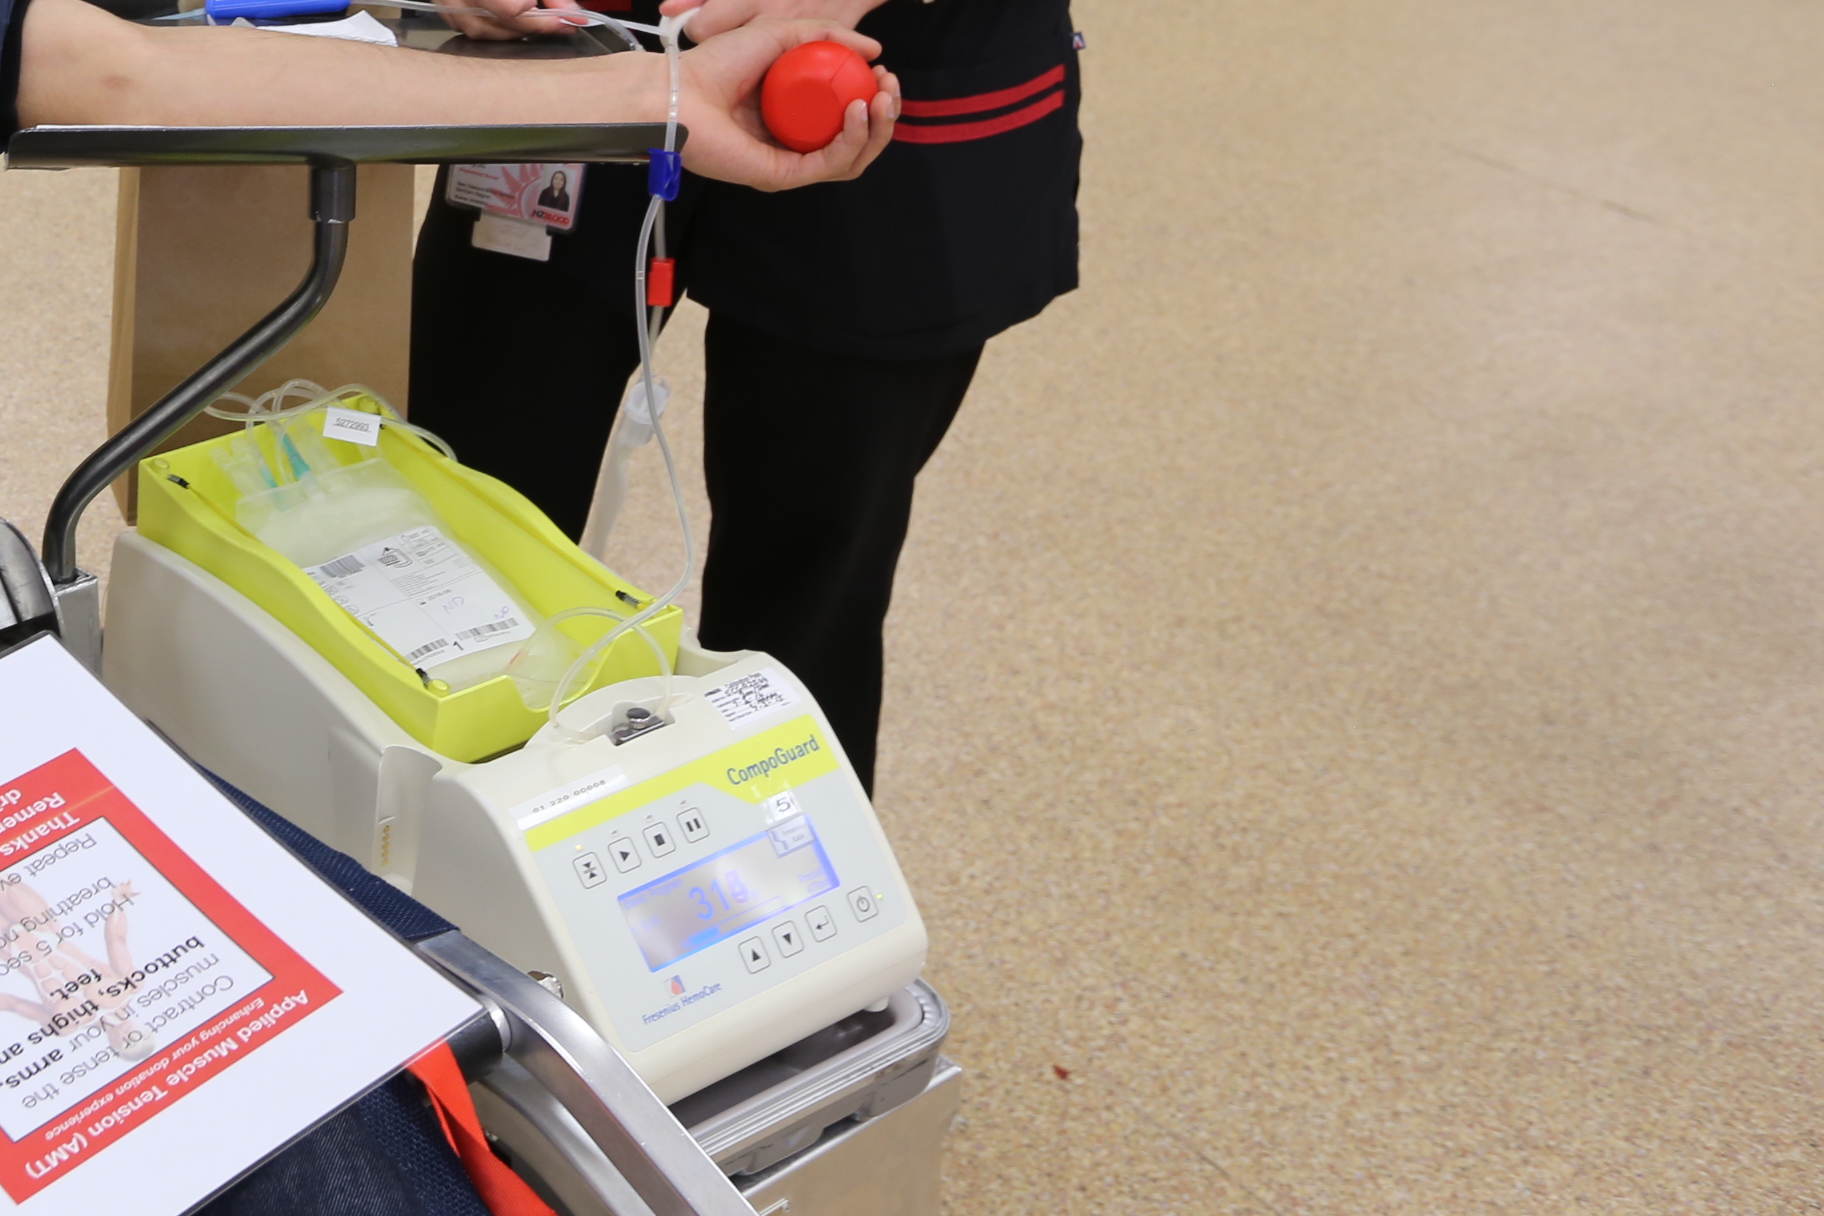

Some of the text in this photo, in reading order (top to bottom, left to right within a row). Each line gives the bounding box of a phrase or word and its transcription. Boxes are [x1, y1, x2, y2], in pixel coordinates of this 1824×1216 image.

[727, 734, 820, 785] CompoGuard
[532, 805, 545, 813] 01
[550, 795, 570, 806] 220
[776, 795, 792, 814] 5
[0, 811, 80, 856] Thanks
[21, 827, 97, 880] Repeat
[17, 870, 116, 938] breathing
[81, 889, 134, 930] Hold
[34, 936, 54, 957] 5
[51, 917, 85, 947] for
[50, 969, 102, 1000] feet.
[95, 930, 205, 1008] buttocks,
[134, 950, 222, 1013] muscles
[28, 1000, 99, 1044] thighs
[111, 1001, 138, 1027] in
[642, 981, 723, 1026] Fresenius HemoCare
[19, 970, 236, 1114] Contract or tense the
[63, 1012, 115, 1054] your
[25, 990, 308, 1178] Applied Muscle Tension (AMT)
[45, 997, 264, 1140] Enhancing your donation experience
